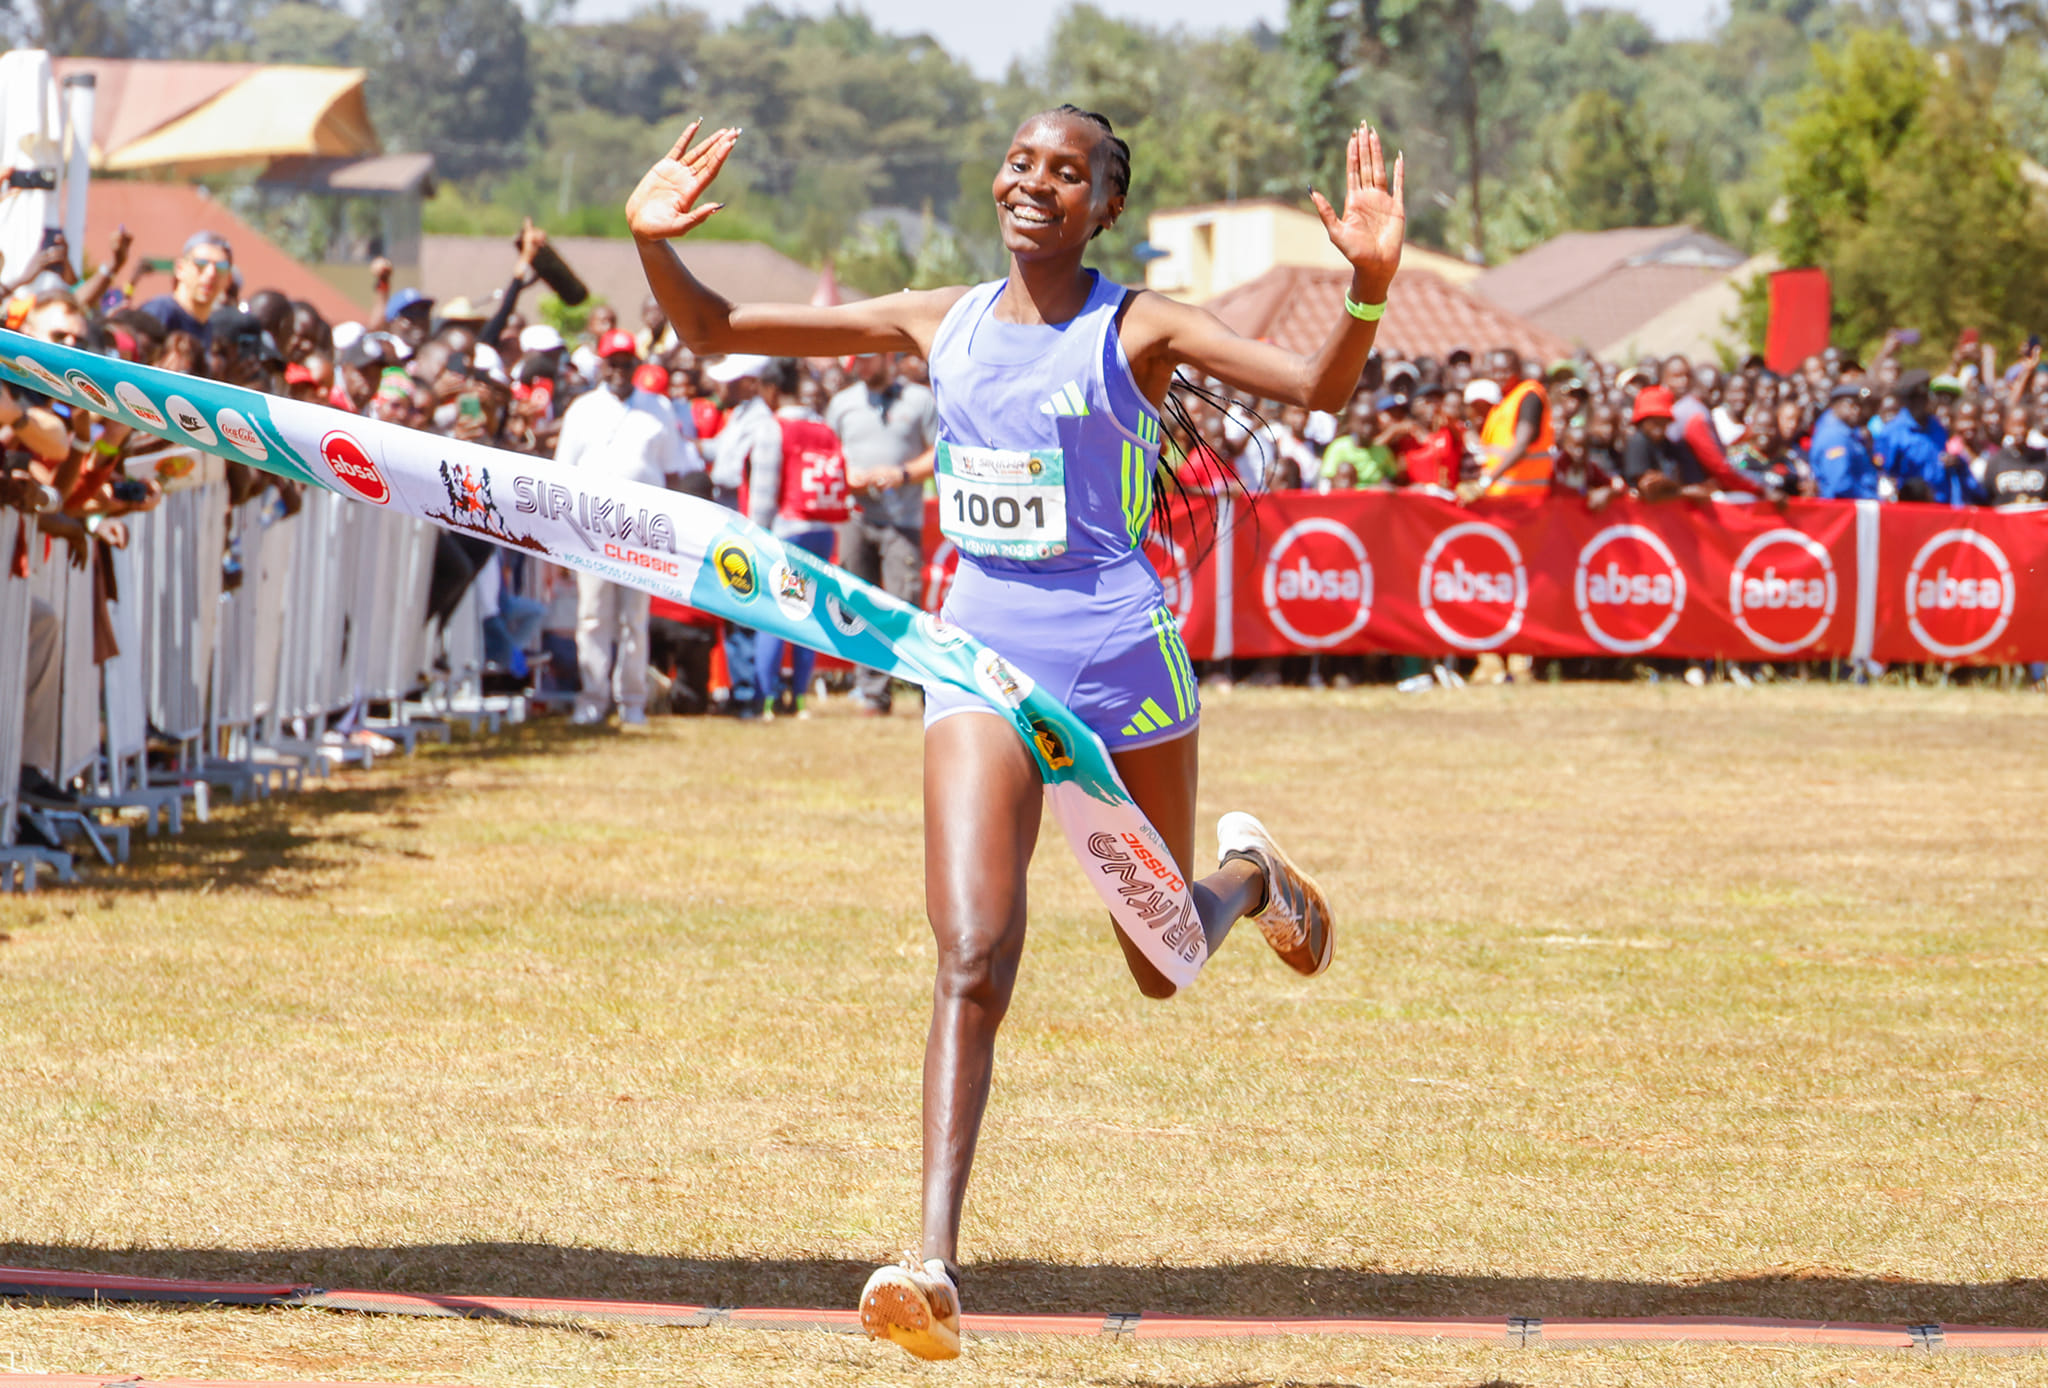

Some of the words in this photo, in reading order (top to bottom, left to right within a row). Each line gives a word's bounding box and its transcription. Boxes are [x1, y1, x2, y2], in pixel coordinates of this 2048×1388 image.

[179, 413, 198, 426] NIKE
[331, 454, 378, 482] absa
[512, 475, 677, 554] SIRIKWA
[953, 489, 1044, 528] 1001
[604, 543, 679, 577] CLASSIC
[965, 538, 999, 556] KENYA
[1277, 556, 1361, 601] absa
[1432, 558, 1515, 603] absa
[1588, 562, 1673, 605] absa
[1743, 567, 1826, 609] absa
[1916, 567, 2002, 610] absa
[1120, 832, 1185, 893] CLASSIC
